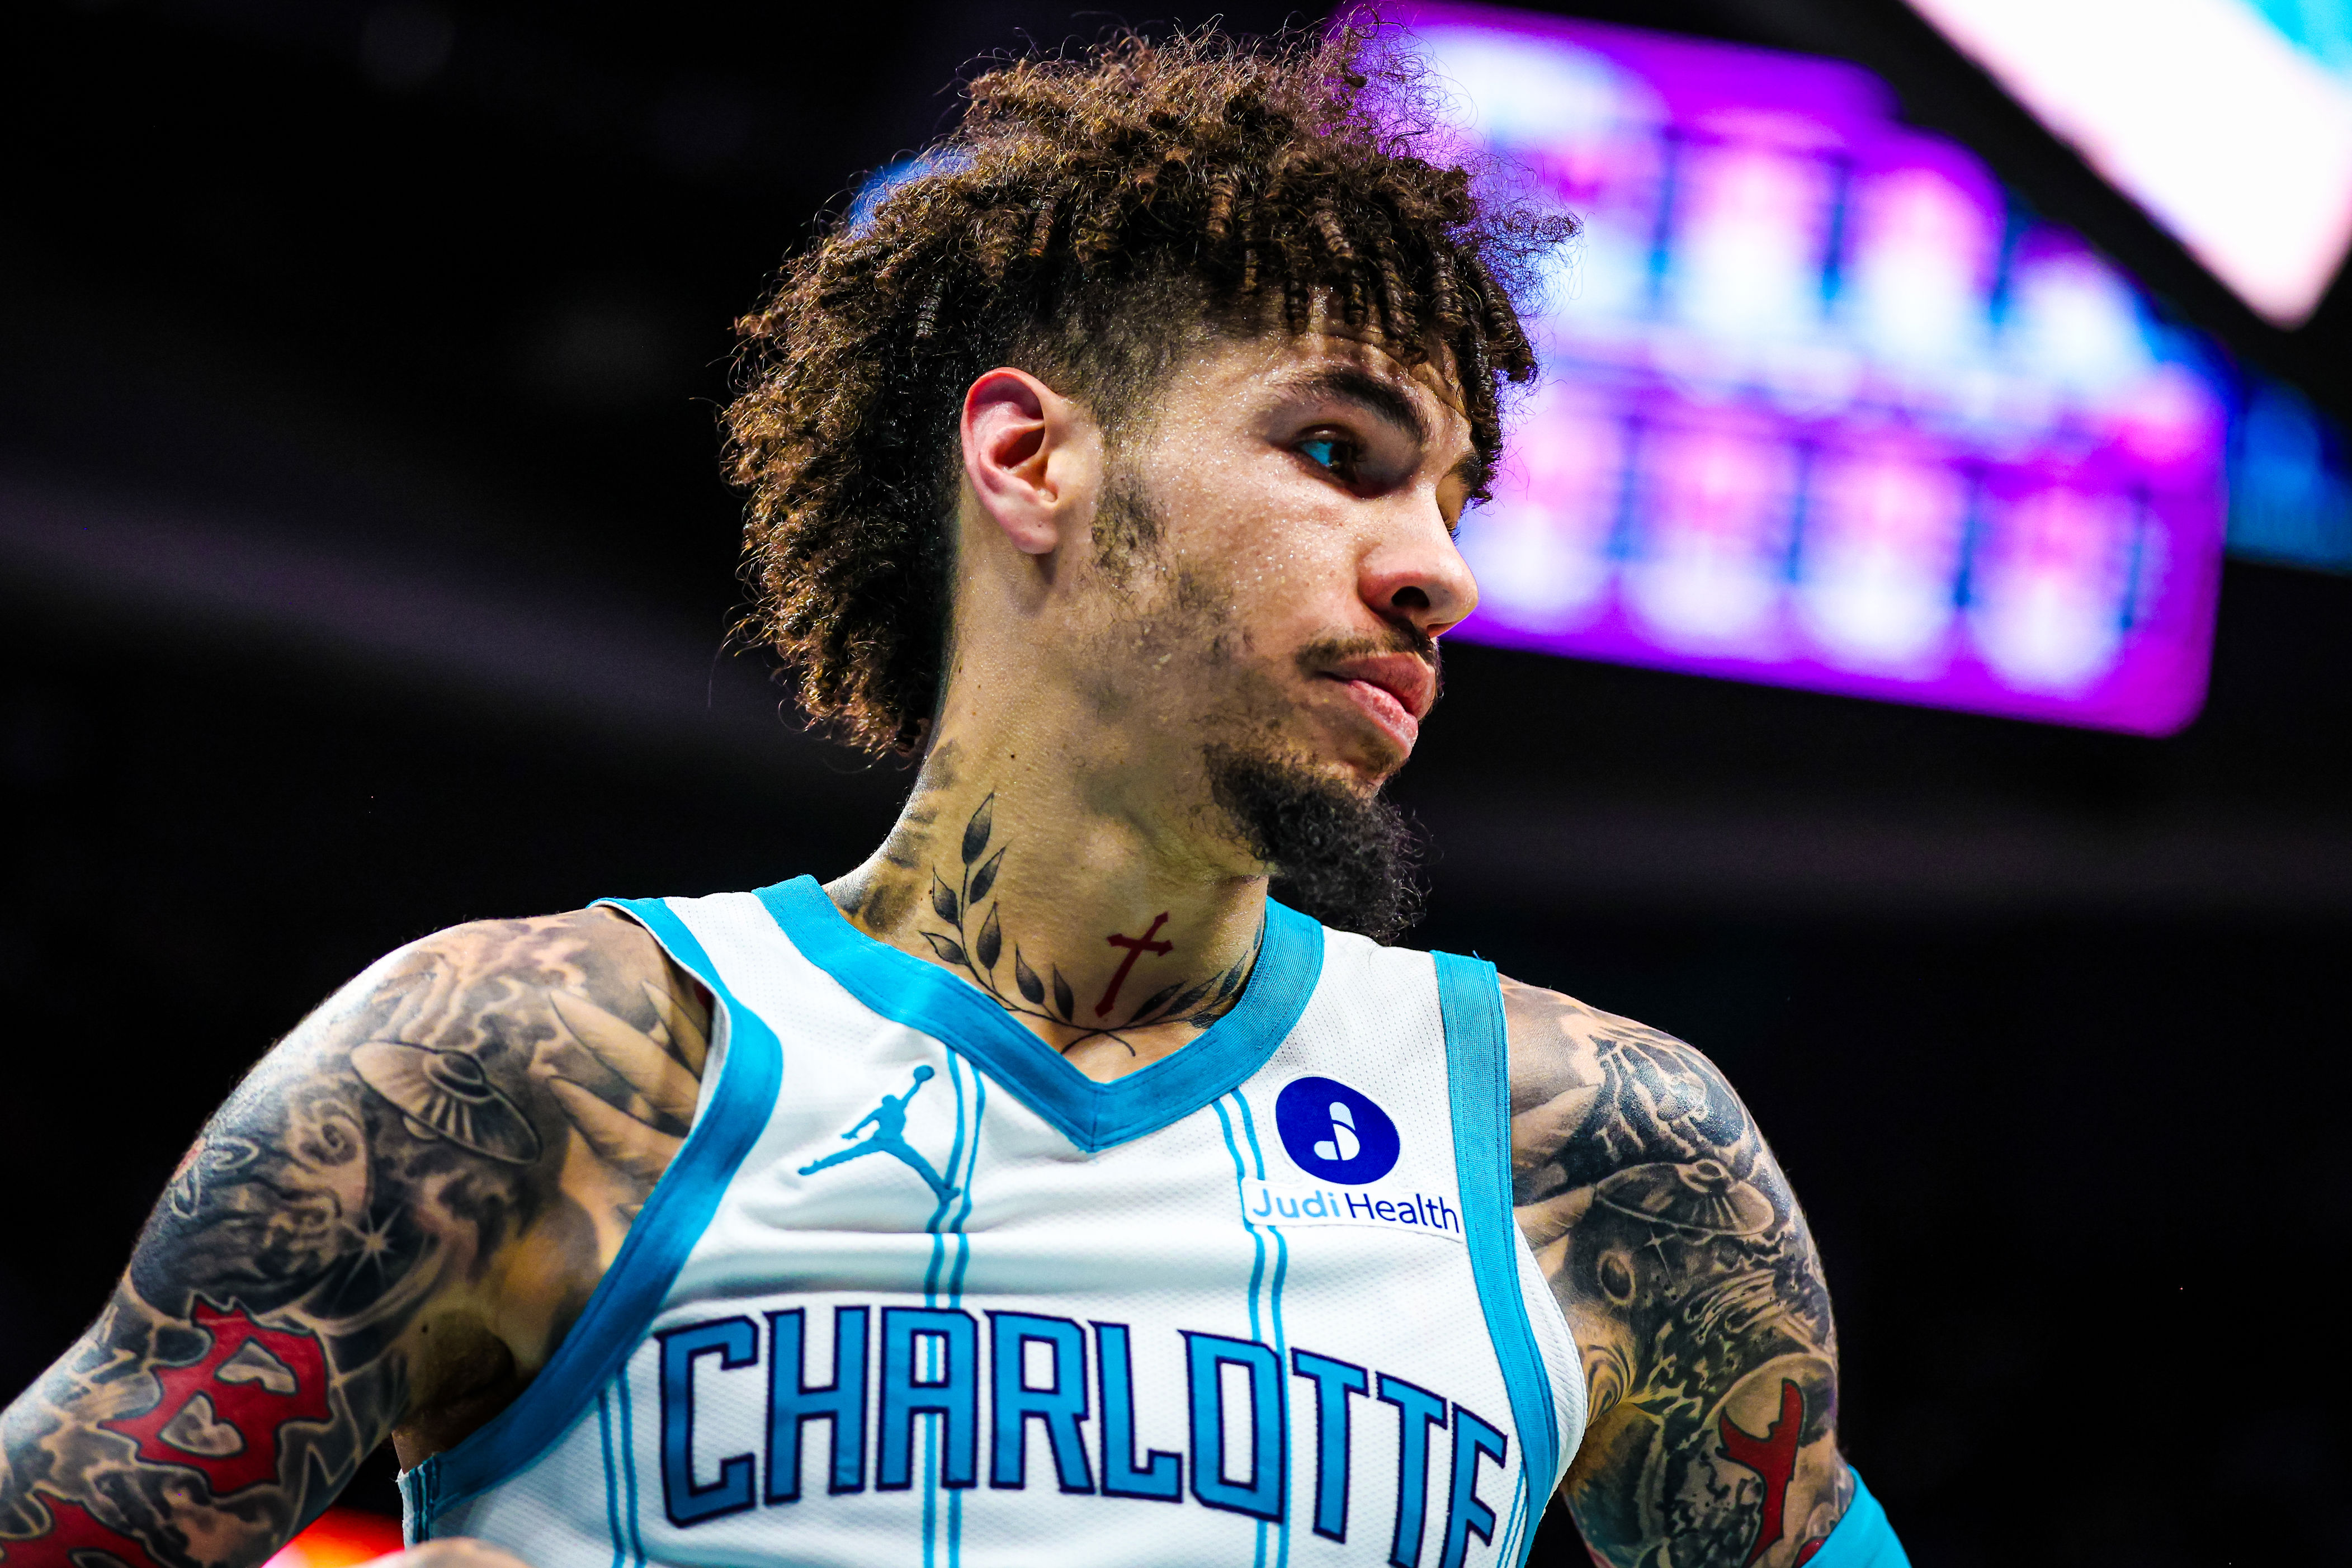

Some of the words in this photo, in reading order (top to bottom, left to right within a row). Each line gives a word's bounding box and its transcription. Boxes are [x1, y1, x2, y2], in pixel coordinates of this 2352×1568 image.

[1252, 1188, 1341, 1218] Judi
[1344, 1192, 1460, 1234] Health
[653, 1304, 1509, 1568] CHARLOTTE
